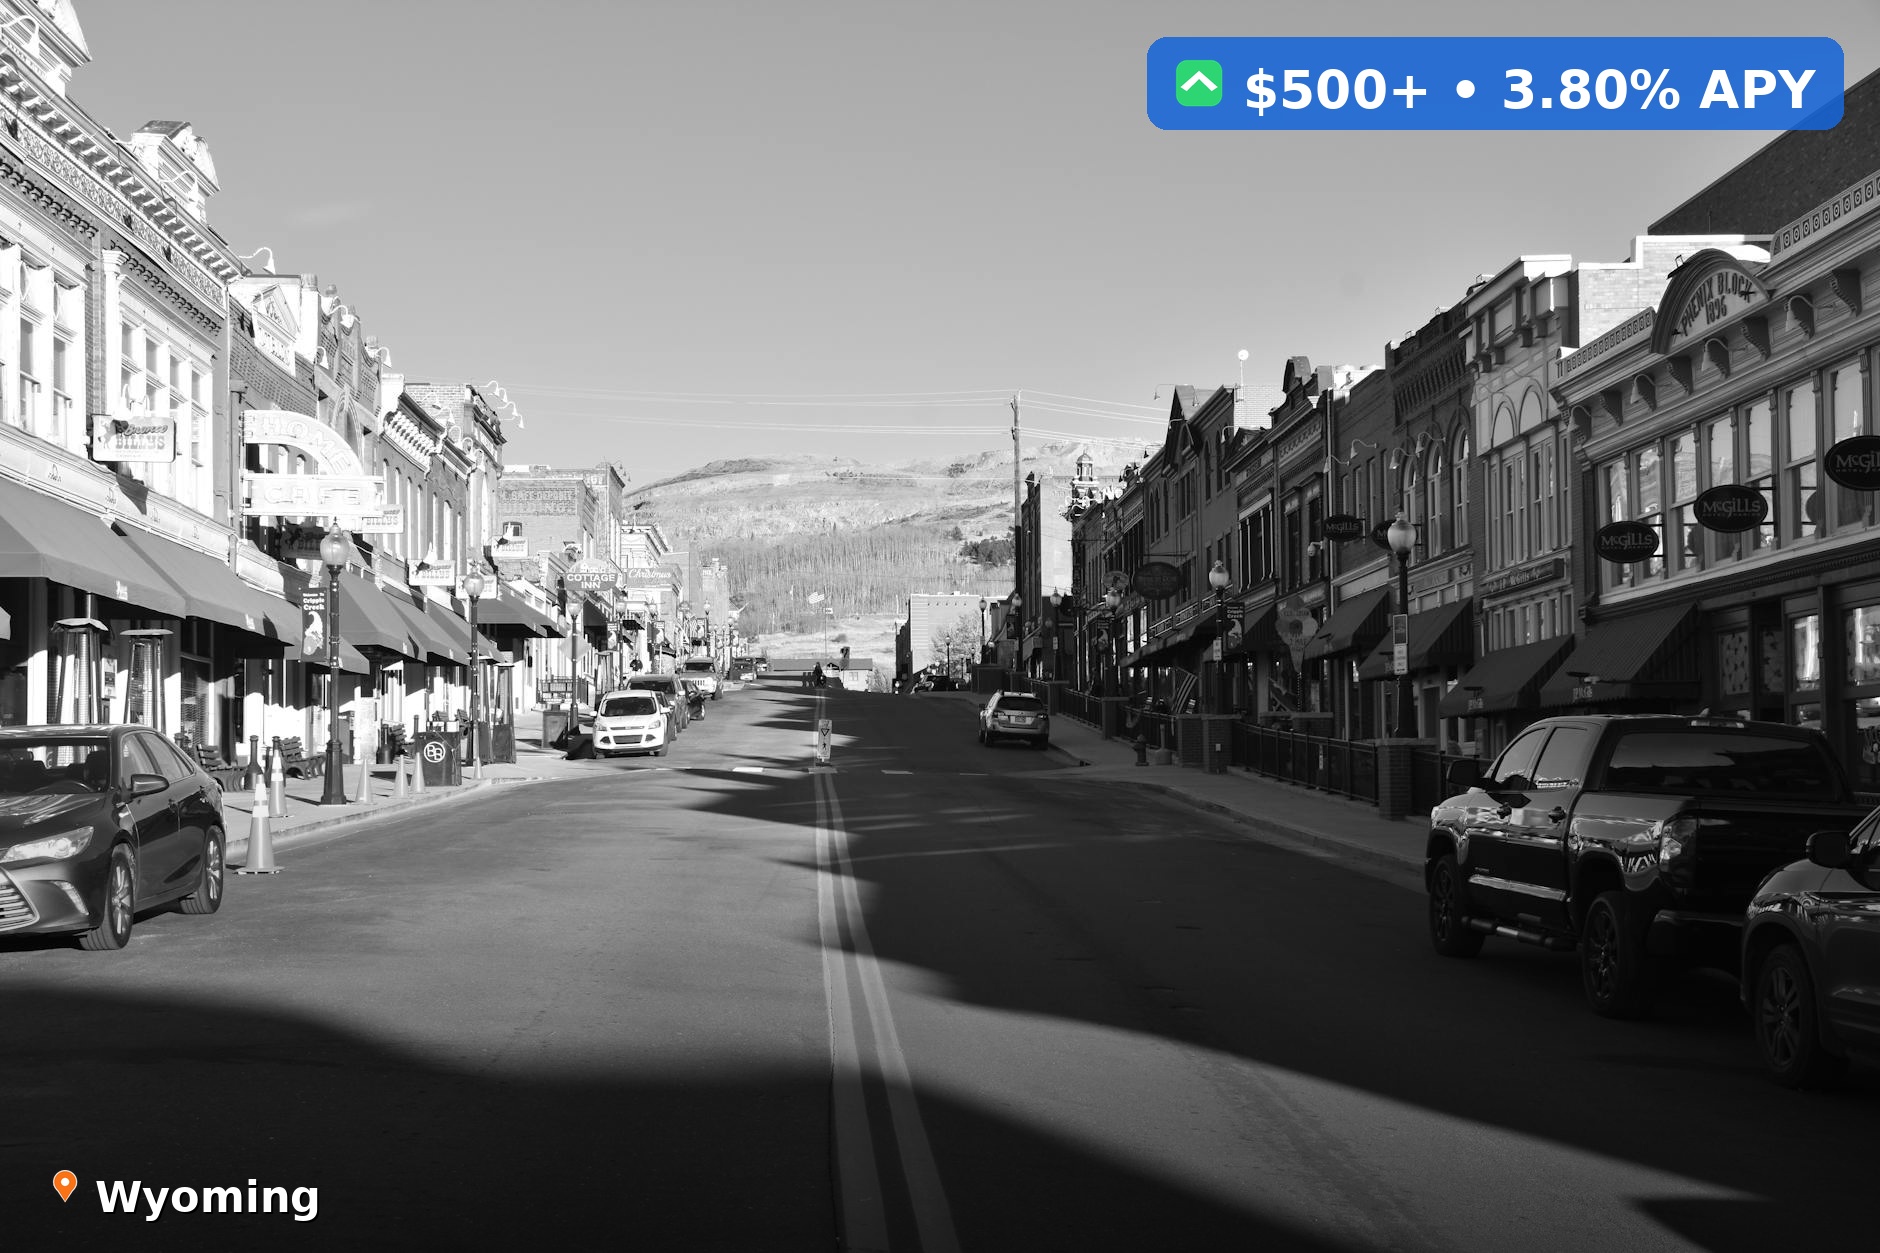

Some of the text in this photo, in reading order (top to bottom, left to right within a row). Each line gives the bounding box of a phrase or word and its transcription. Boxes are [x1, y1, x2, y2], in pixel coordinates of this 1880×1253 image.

[1681, 271, 1753, 337] PHENIX BLOCK
[1705, 295, 1727, 325] 1896
[262, 412, 354, 474] HOME
[263, 485, 362, 506] CAFE
[566, 573, 617, 582] COTTAGE
[580, 581, 601, 589] INN
